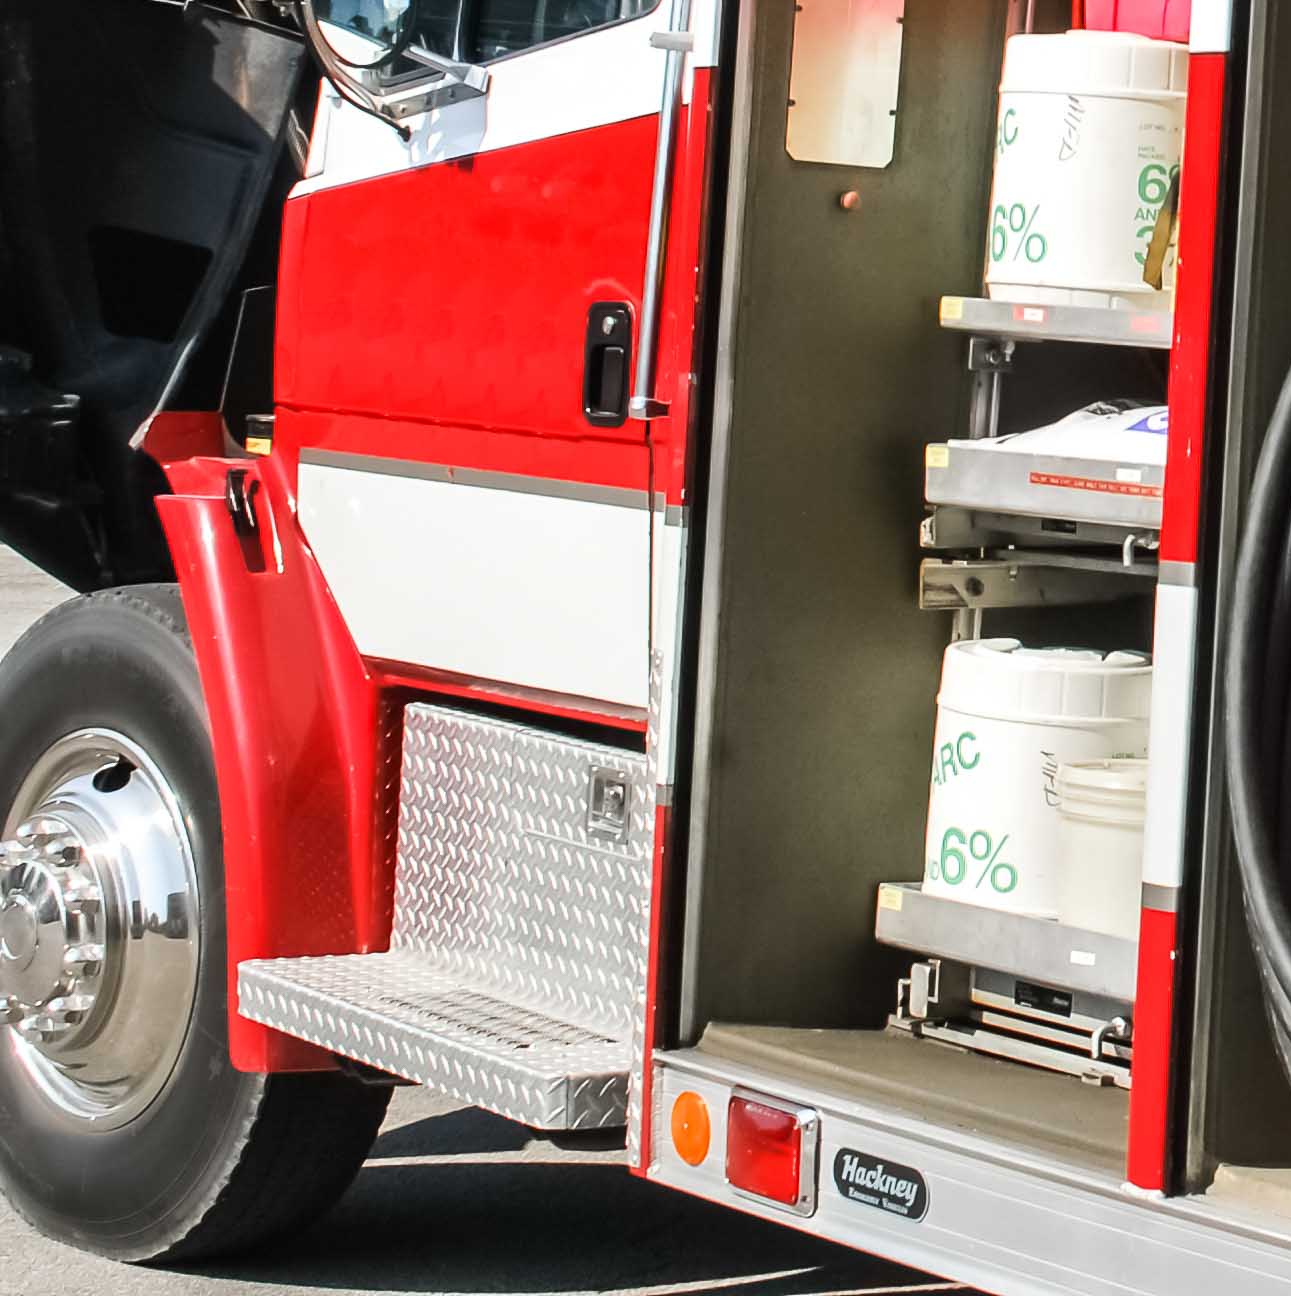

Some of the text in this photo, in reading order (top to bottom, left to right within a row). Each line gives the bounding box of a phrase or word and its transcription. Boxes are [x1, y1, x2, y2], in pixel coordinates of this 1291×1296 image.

[991, 203, 1047, 263] 6%
[1134, 207, 1157, 221] AN
[940, 827, 1018, 893] 6%
[841, 1154, 918, 1207] Hackney
